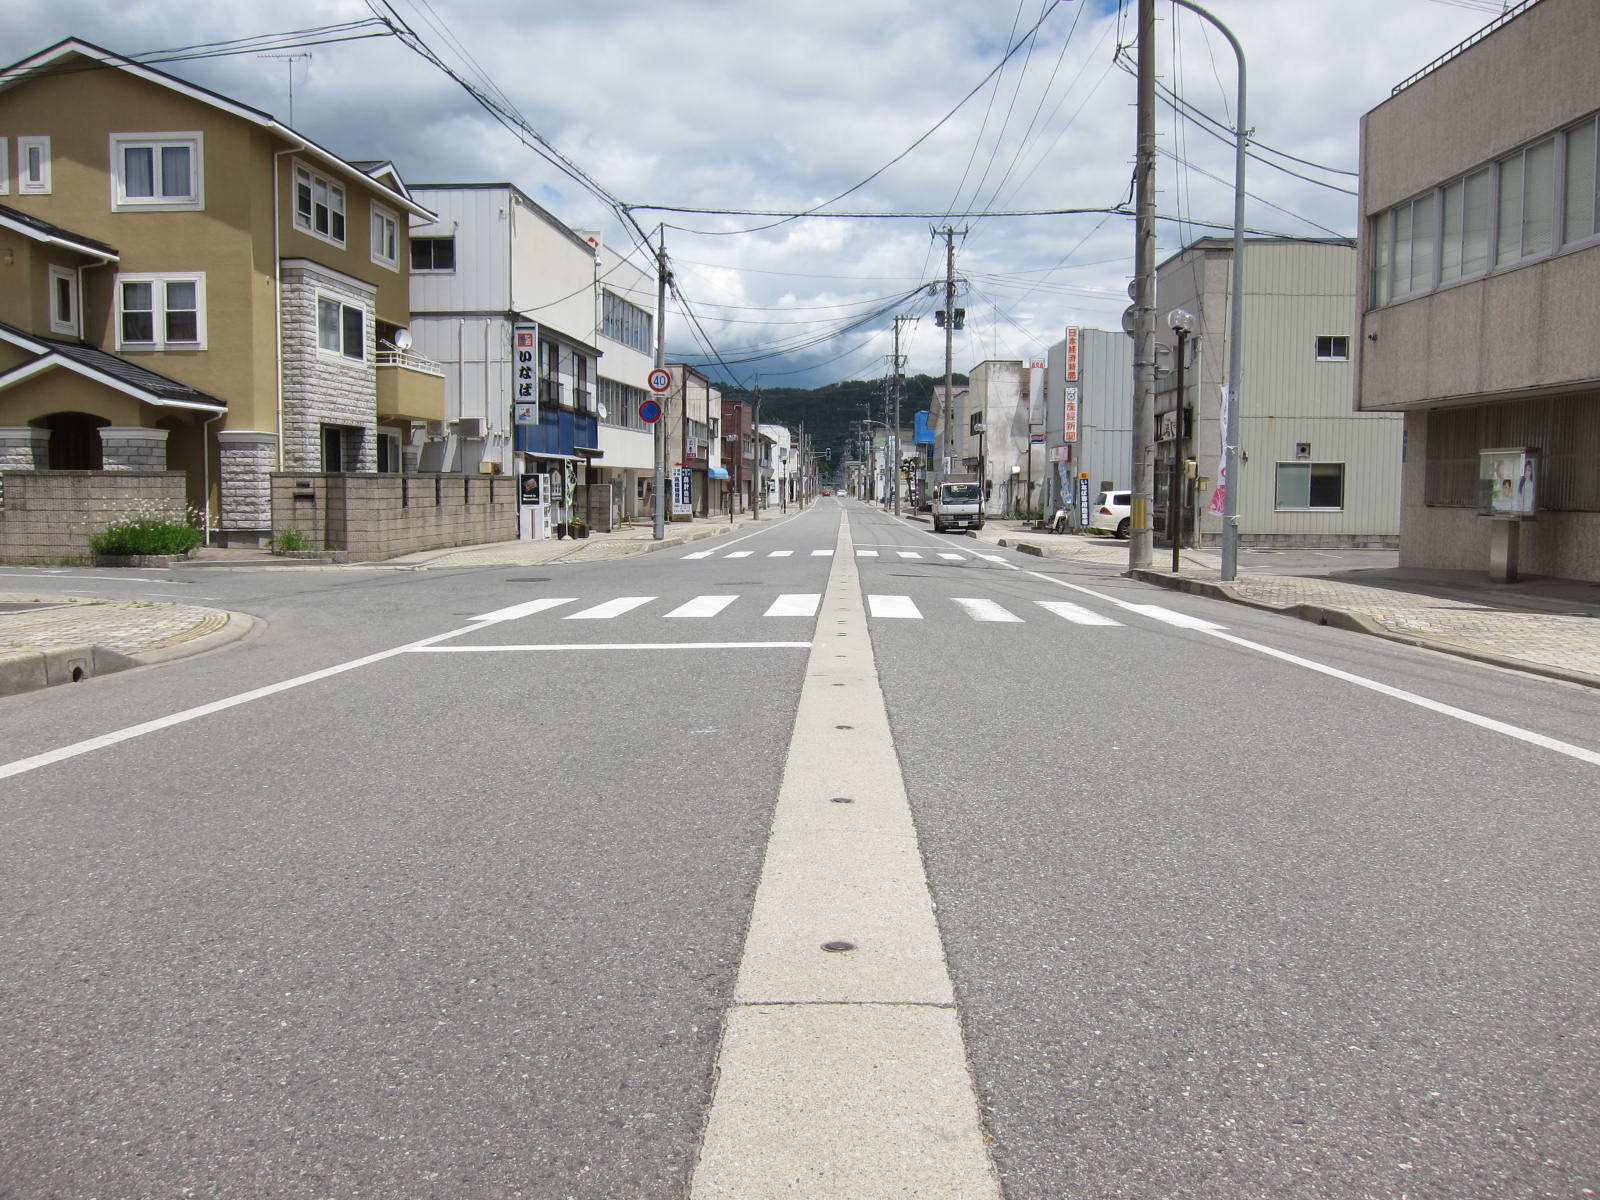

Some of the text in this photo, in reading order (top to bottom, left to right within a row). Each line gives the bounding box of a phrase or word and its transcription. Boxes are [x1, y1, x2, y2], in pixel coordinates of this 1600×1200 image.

[519, 350, 532, 397] いなば
[1067, 328, 1077, 380] 日本経済新聞
[653, 375, 666, 386] 40
[1066, 402, 1076, 441] 産経新聞
